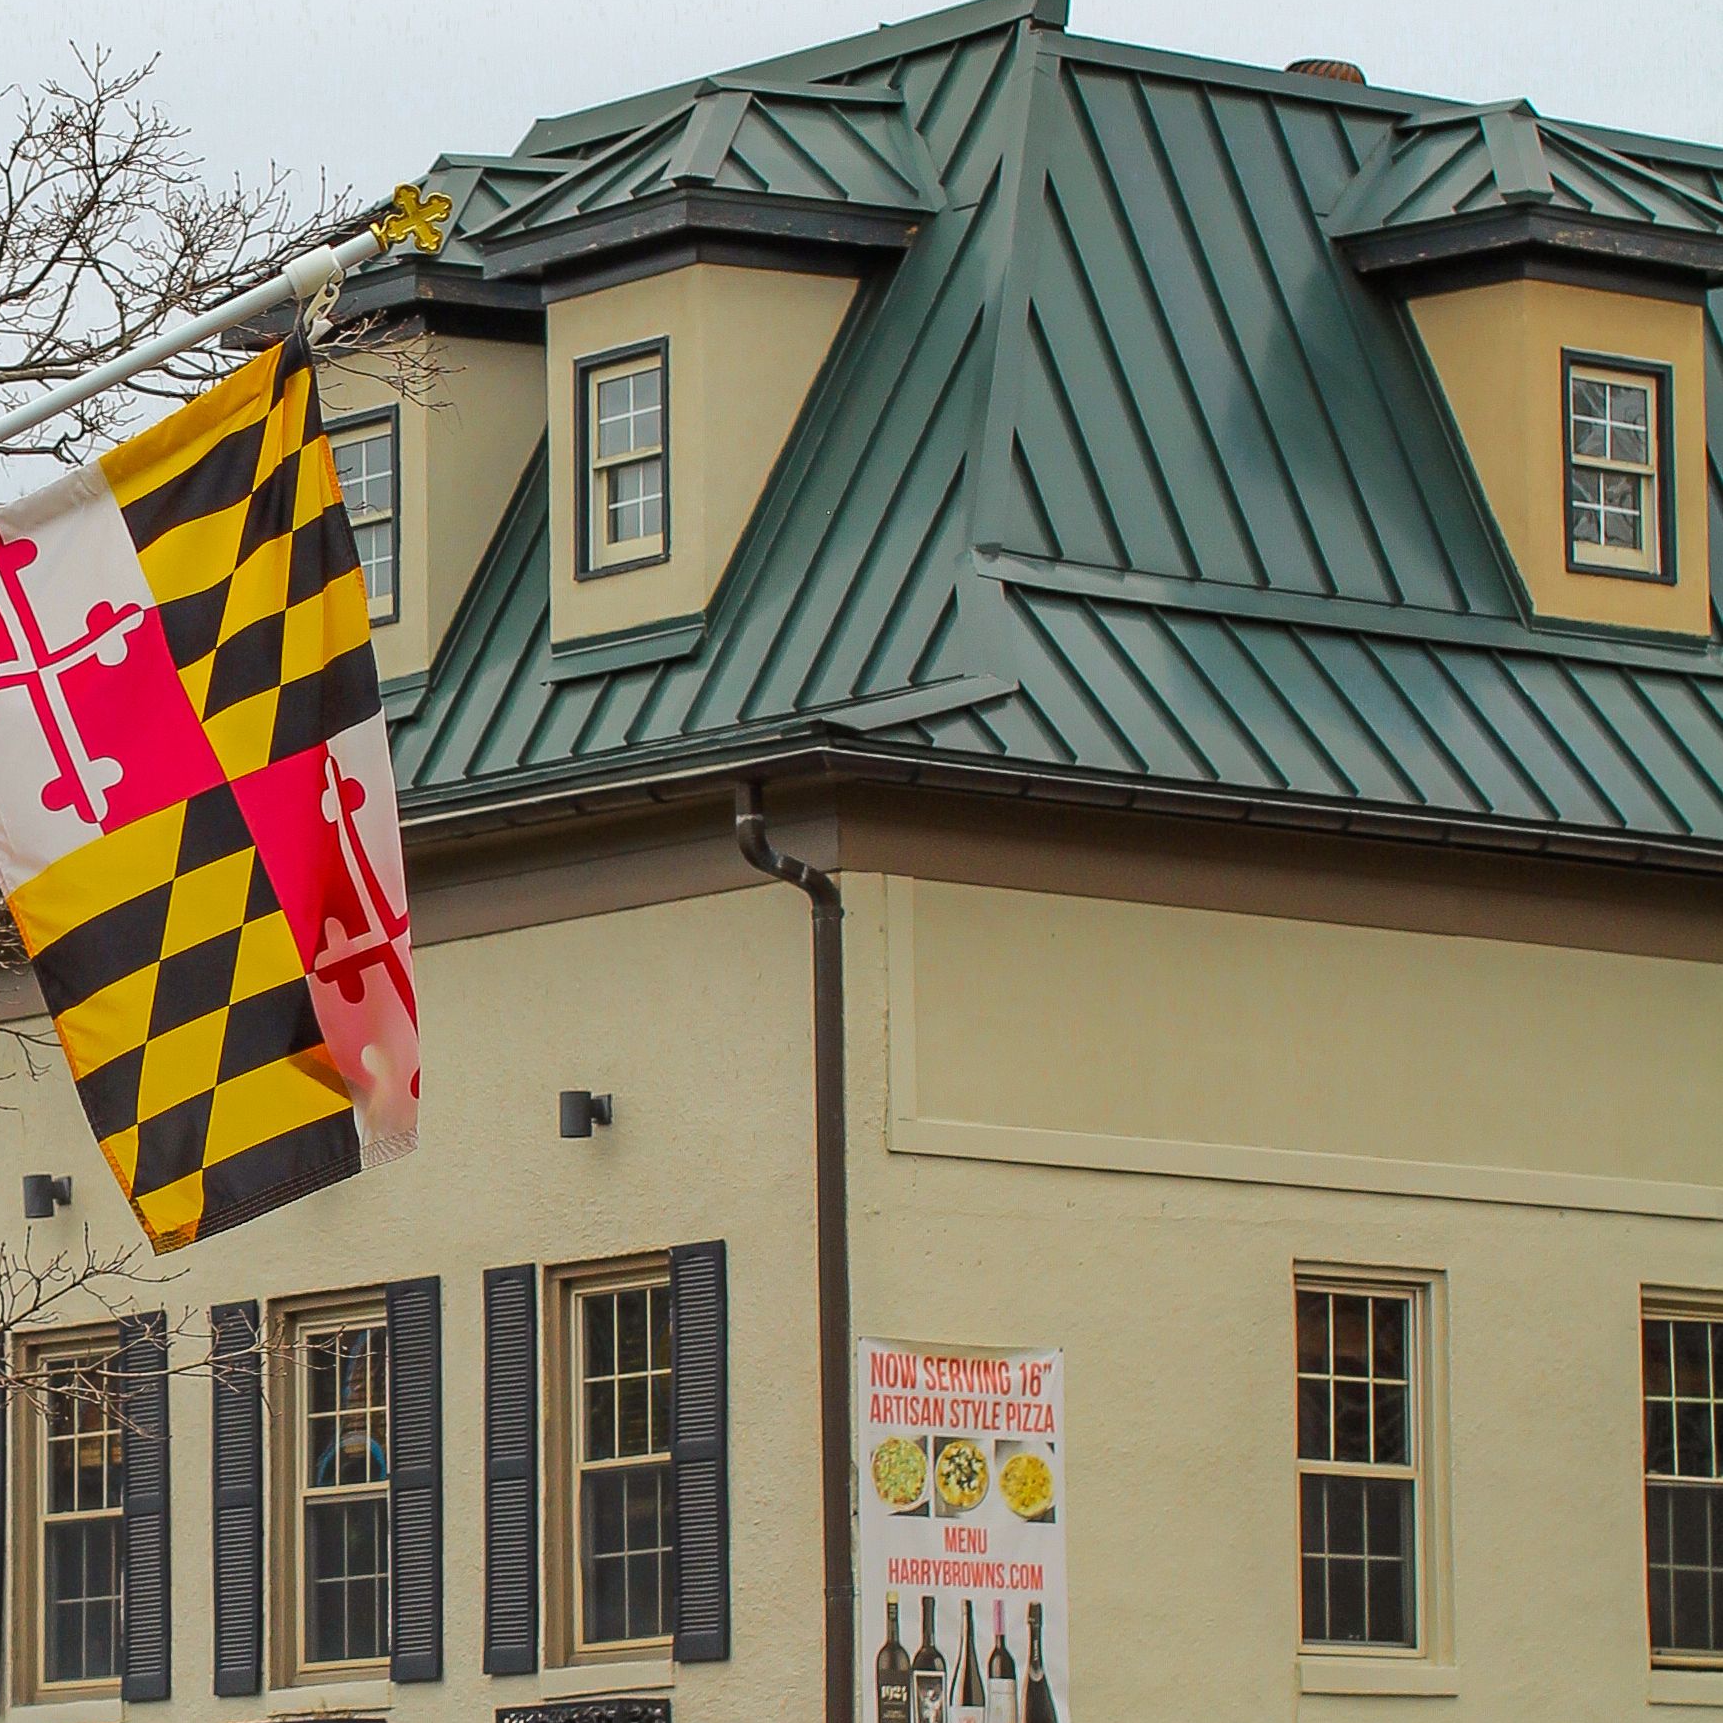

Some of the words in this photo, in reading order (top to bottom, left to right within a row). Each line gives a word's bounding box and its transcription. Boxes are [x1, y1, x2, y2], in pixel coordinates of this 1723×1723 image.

[870, 1352, 917, 1389] NOW
[923, 1356, 1012, 1396] SERVING
[869, 1393, 945, 1427] ARTISAN
[949, 1398, 1001, 1430] STYLE
[1005, 1401, 1056, 1433] PIZZA
[944, 1526, 988, 1554] MENU
[888, 1557, 1044, 1591] HARRYBROWNS.COM
